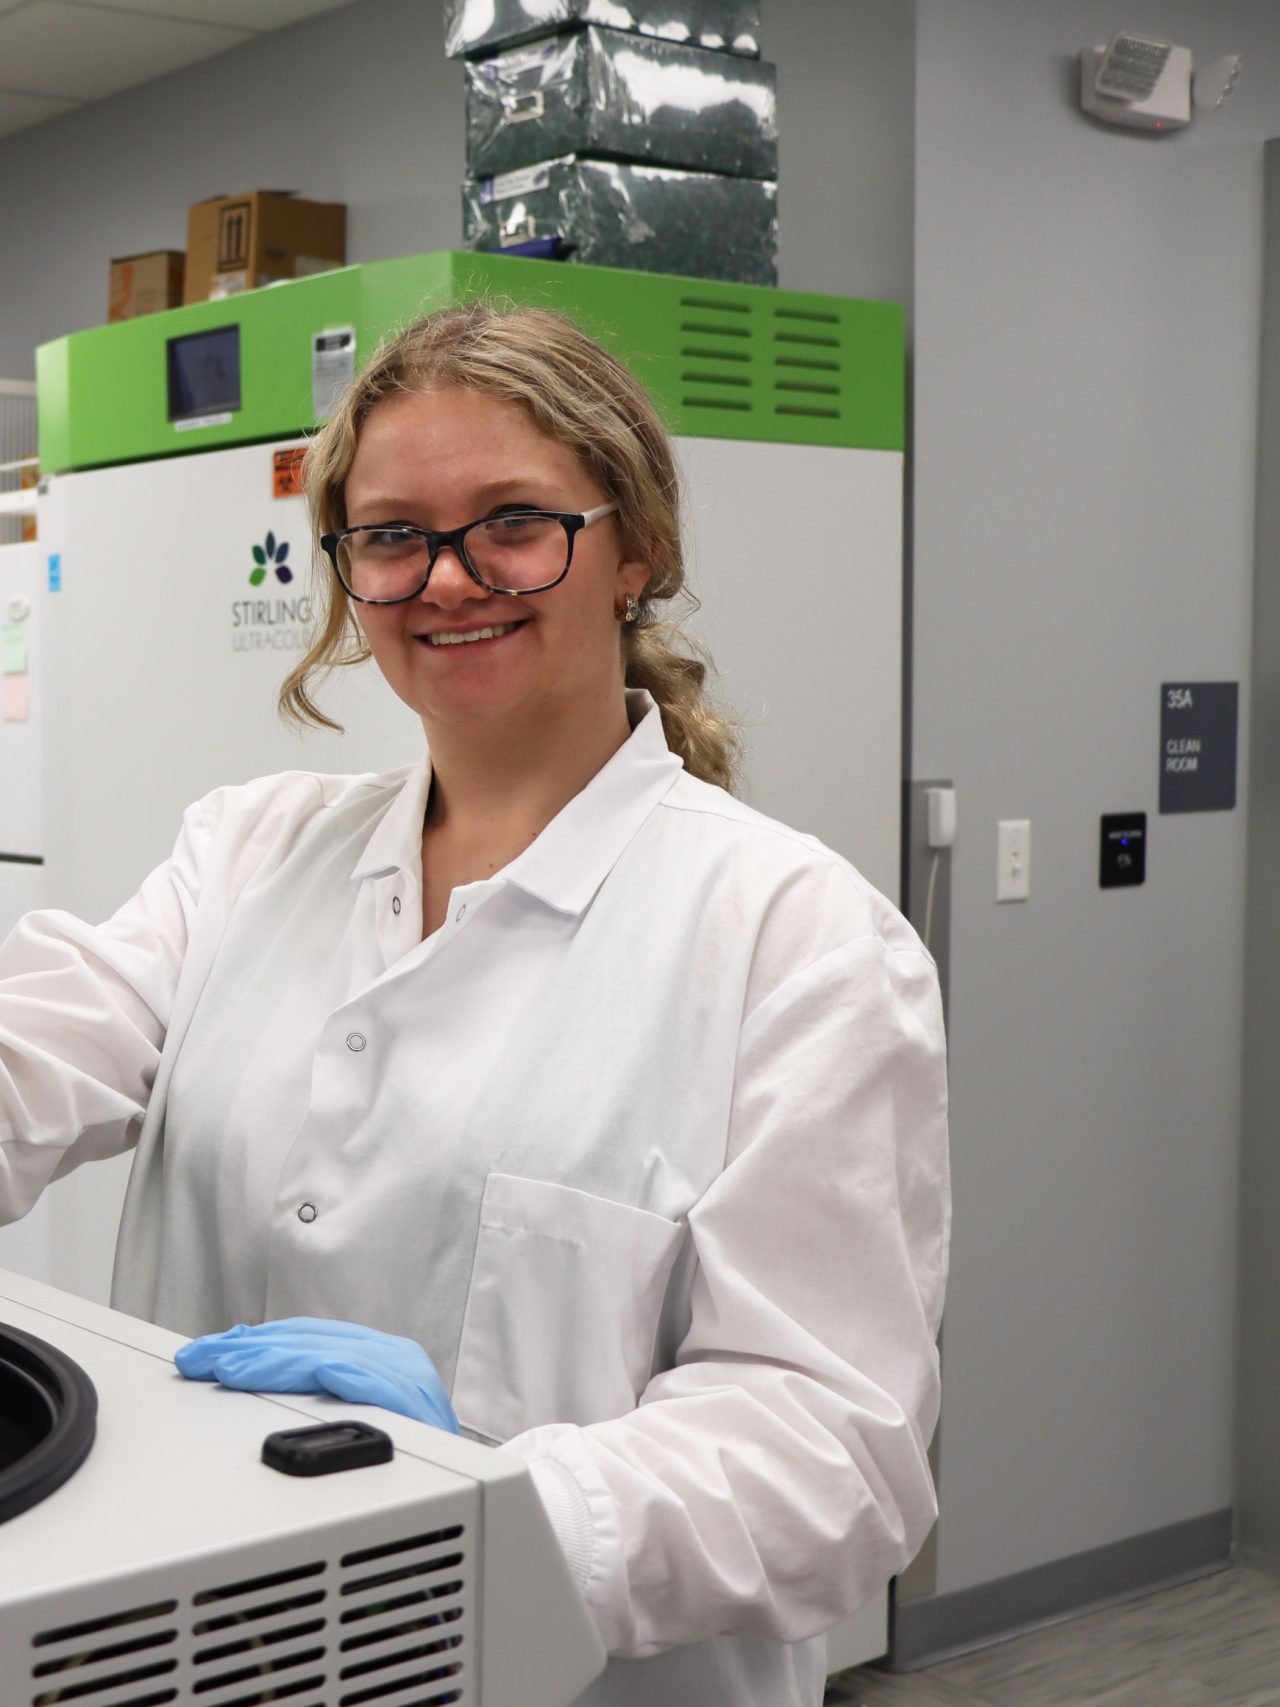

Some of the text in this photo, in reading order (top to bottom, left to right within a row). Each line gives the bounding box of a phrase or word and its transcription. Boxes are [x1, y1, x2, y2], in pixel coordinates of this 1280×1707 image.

[232, 597, 312, 627] STIRLING
[1167, 688, 1193, 709] 35A
[1166, 738, 1201, 755] CLEAN
[1165, 755, 1199, 772] ROOM
